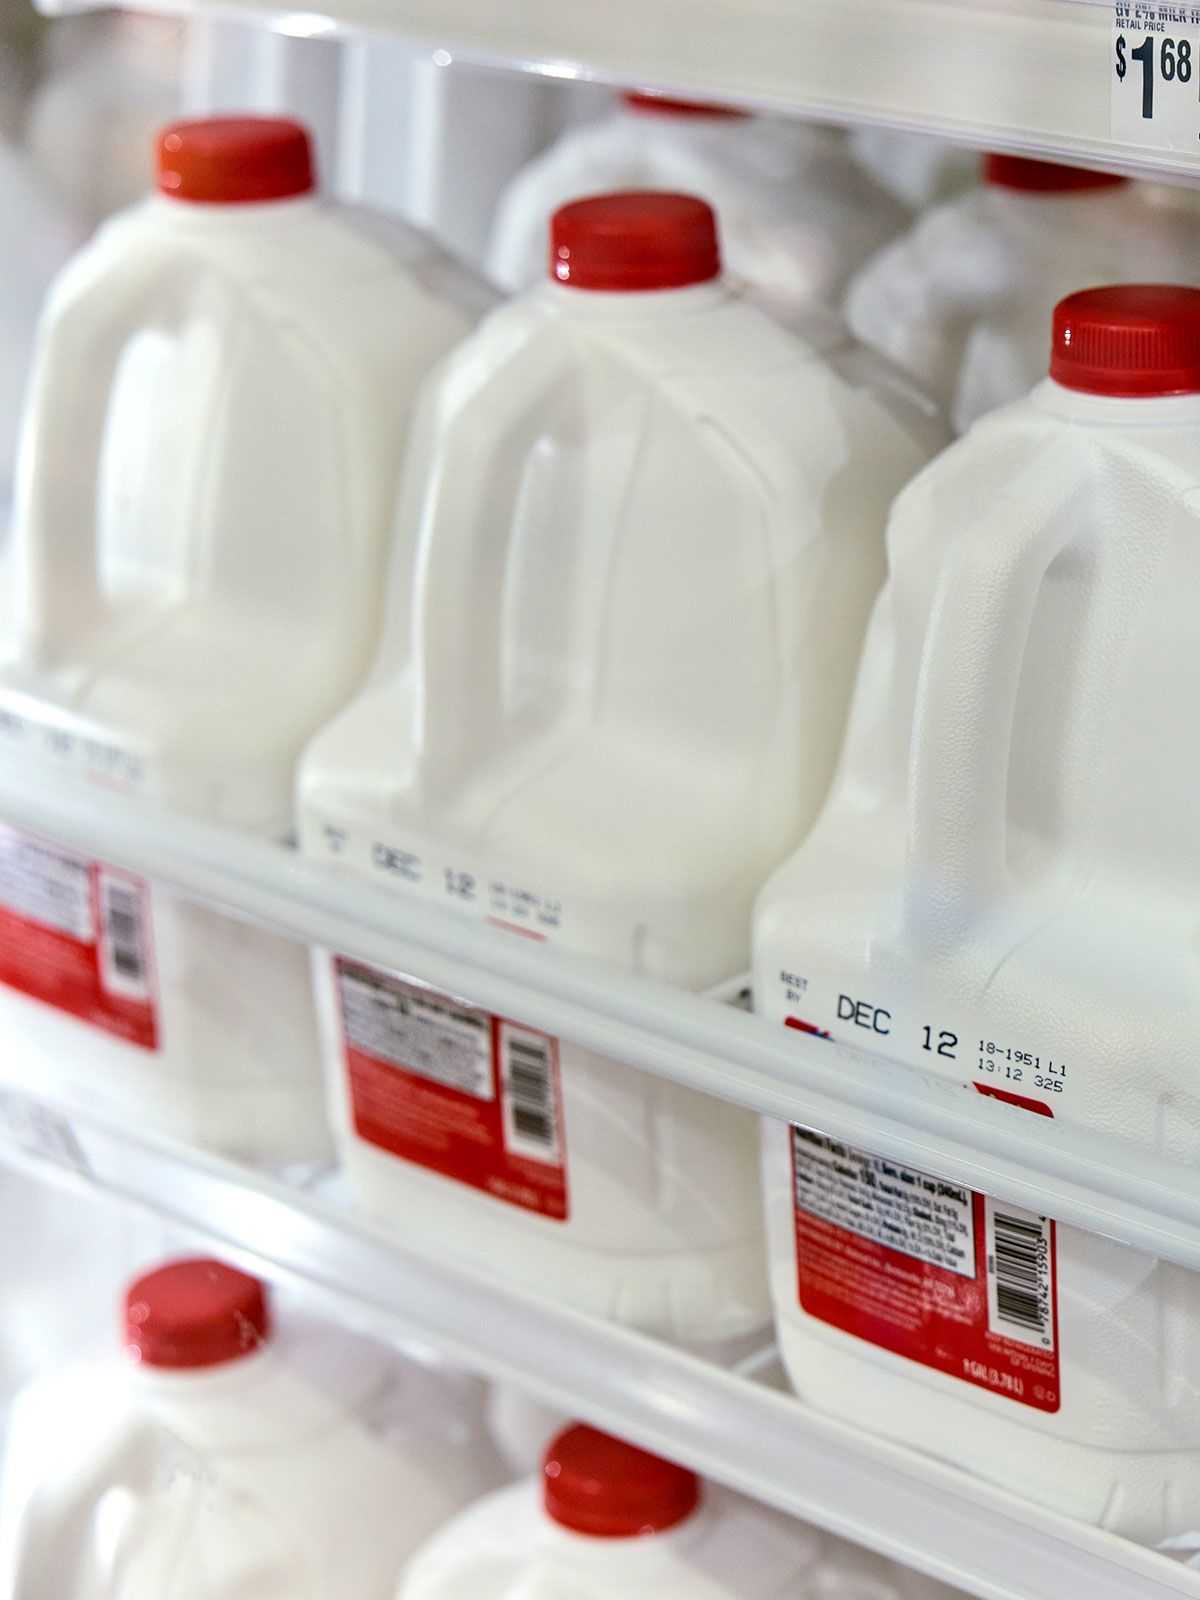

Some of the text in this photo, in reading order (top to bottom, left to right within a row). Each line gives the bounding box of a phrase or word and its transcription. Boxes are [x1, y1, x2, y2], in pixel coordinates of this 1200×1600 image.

[1116, 18, 1165, 32] RETAIL PRICE
[837, 994, 958, 1059] DEC 12
[979, 1040, 1067, 1077] 18-1951 L1
[1034, 1075, 1063, 1093] 325
